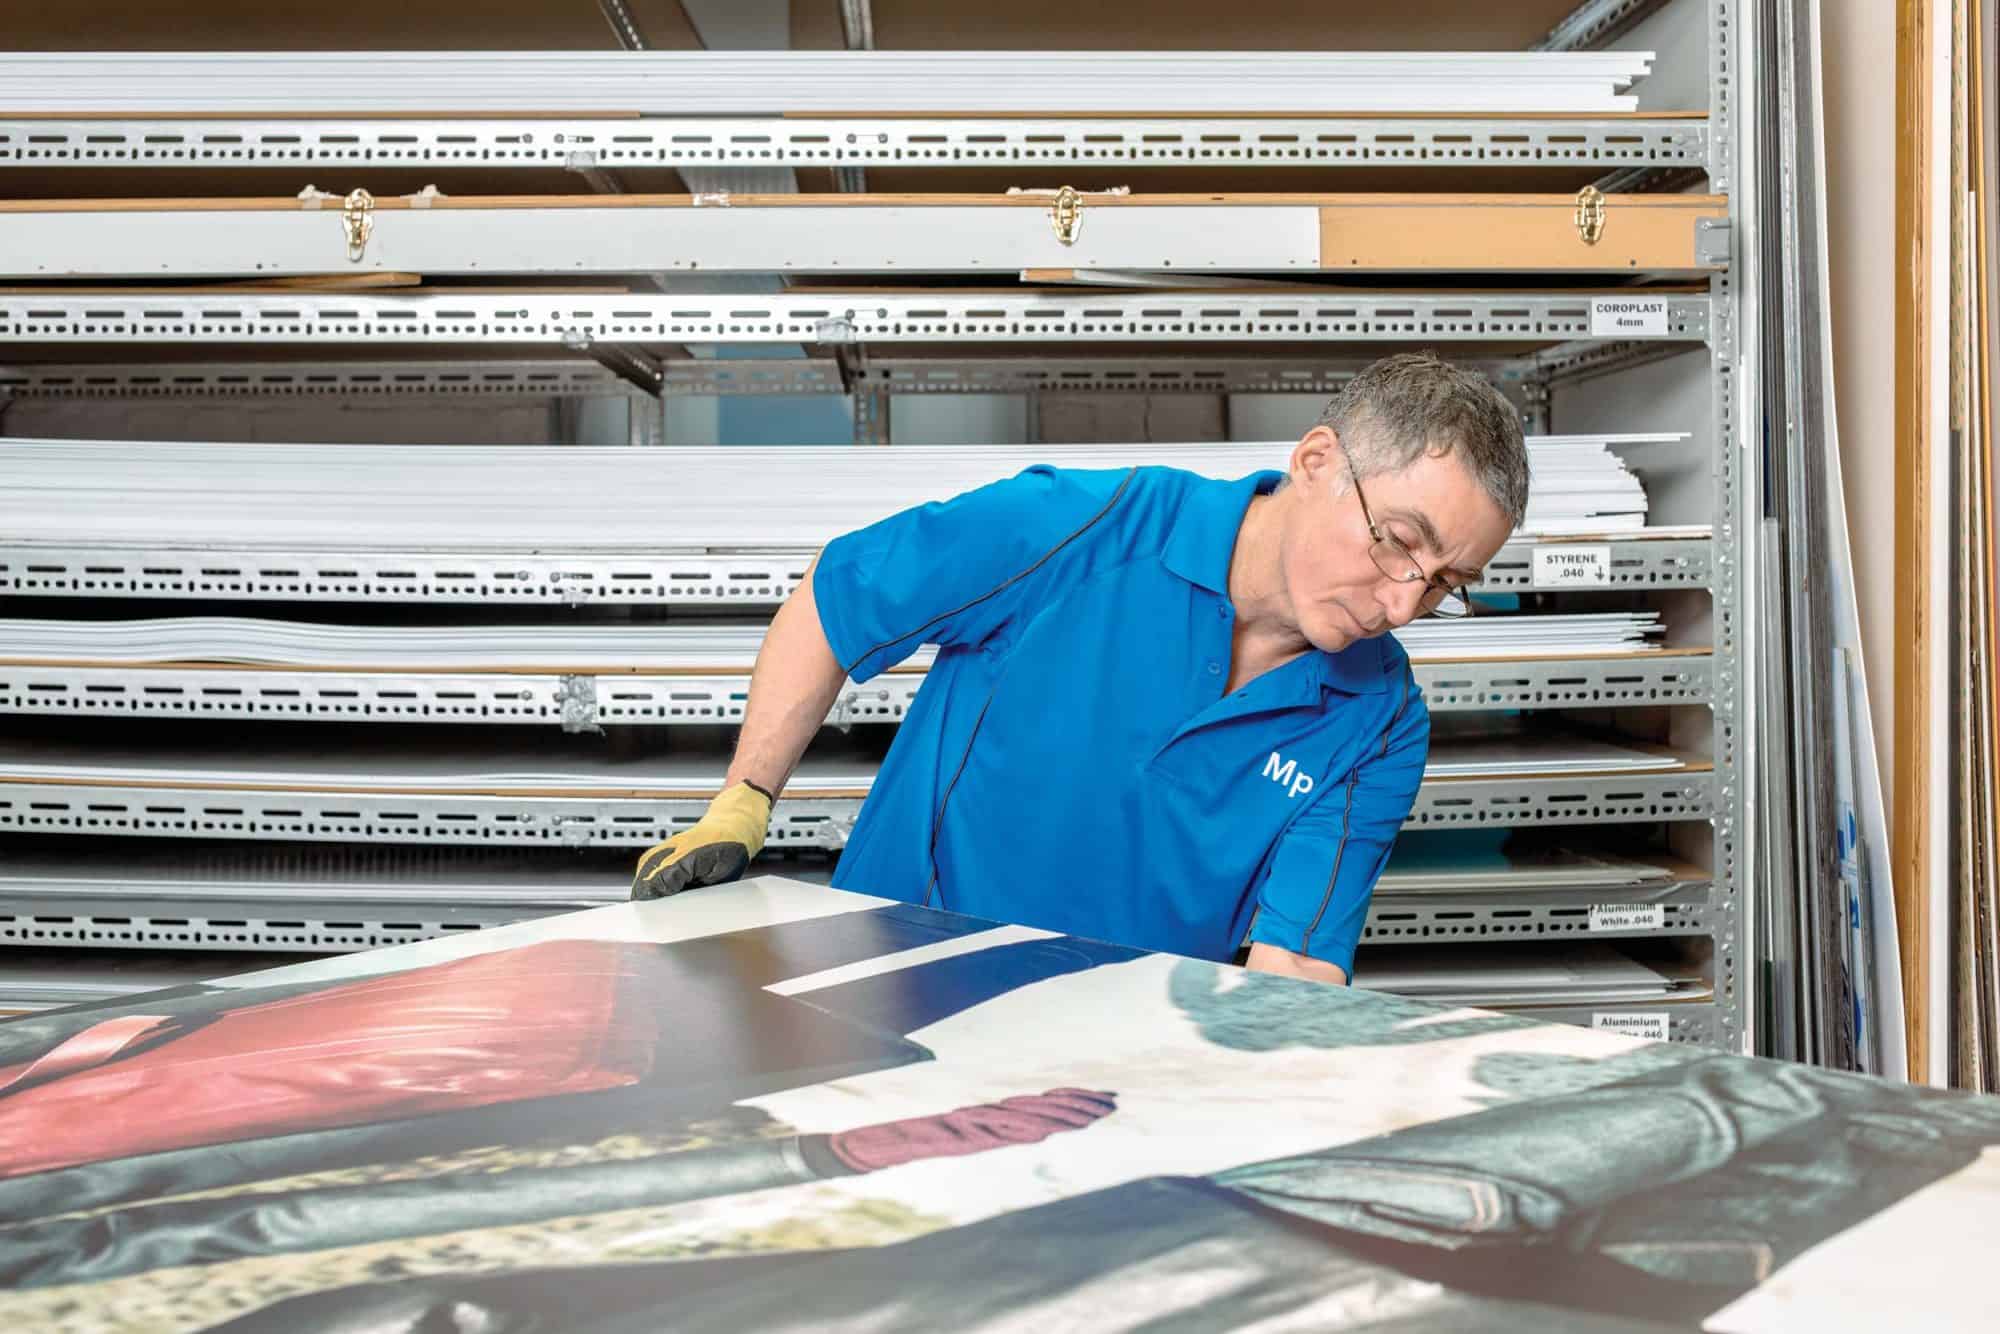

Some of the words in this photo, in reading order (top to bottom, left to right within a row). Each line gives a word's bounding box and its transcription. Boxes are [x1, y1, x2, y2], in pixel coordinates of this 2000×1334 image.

[1596, 303, 1663, 313] COROPLAST
[1616, 318, 1644, 327] 4mm
[1546, 554, 1597, 565] STYRENE
[1560, 568, 1584, 578] .040
[1261, 751, 1314, 798] Mp
[1598, 903, 1656, 912] Aluminium
[1601, 916, 1629, 927] White
[1632, 915, 1654, 925] .040
[1601, 1017, 1660, 1027] Aluminium
